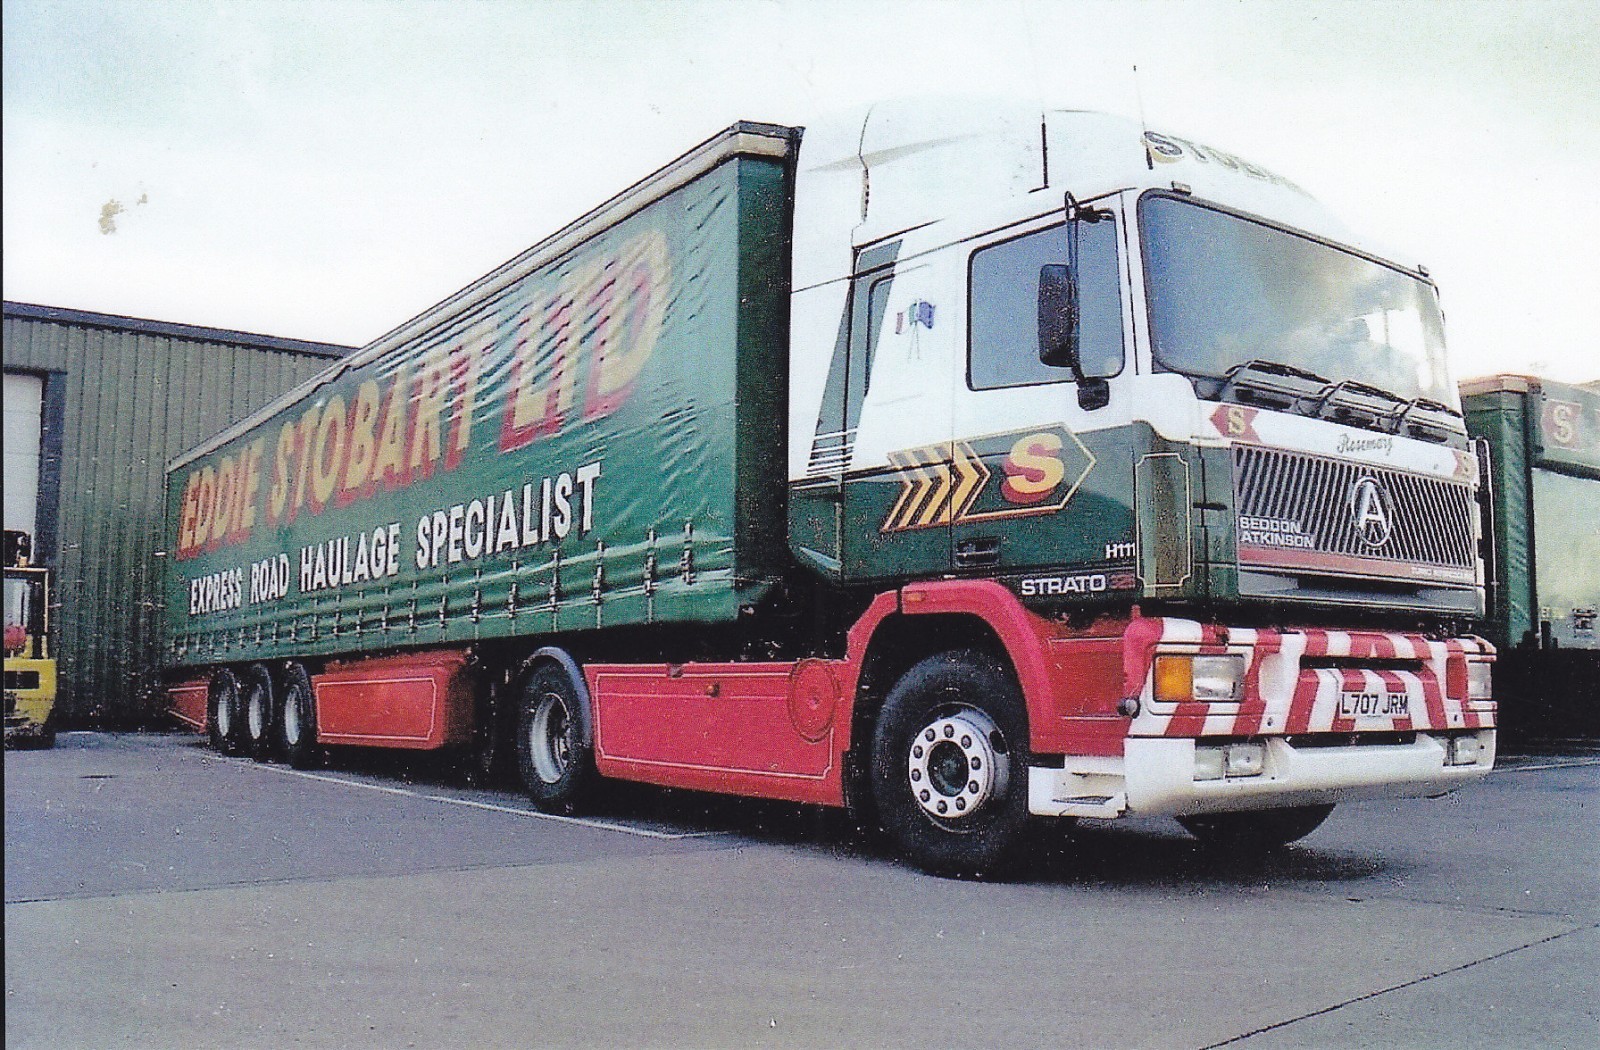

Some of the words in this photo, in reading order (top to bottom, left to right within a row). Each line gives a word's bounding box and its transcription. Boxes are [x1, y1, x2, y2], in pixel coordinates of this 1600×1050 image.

[176, 441, 263, 560] EDDIE
[266, 322, 494, 528] STOBART
[499, 230, 671, 452] LTD
[1227, 405, 1247, 434] S
[1552, 404, 1573, 444] S
[1000, 432, 1066, 504] S
[190, 566, 243, 616] EXPRESS
[250, 552, 291, 604] ROAD
[300, 522, 401, 593] HAULAGE
[415, 462, 601, 571] SPECIALIST
[1239, 516, 1302, 534] SEDDON
[1240, 530, 1316, 549] ATKINSON
[1021, 574, 1106, 596] STRATO
[1341, 693, 1379, 715] L707
[1382, 694, 1408, 715] JRM
